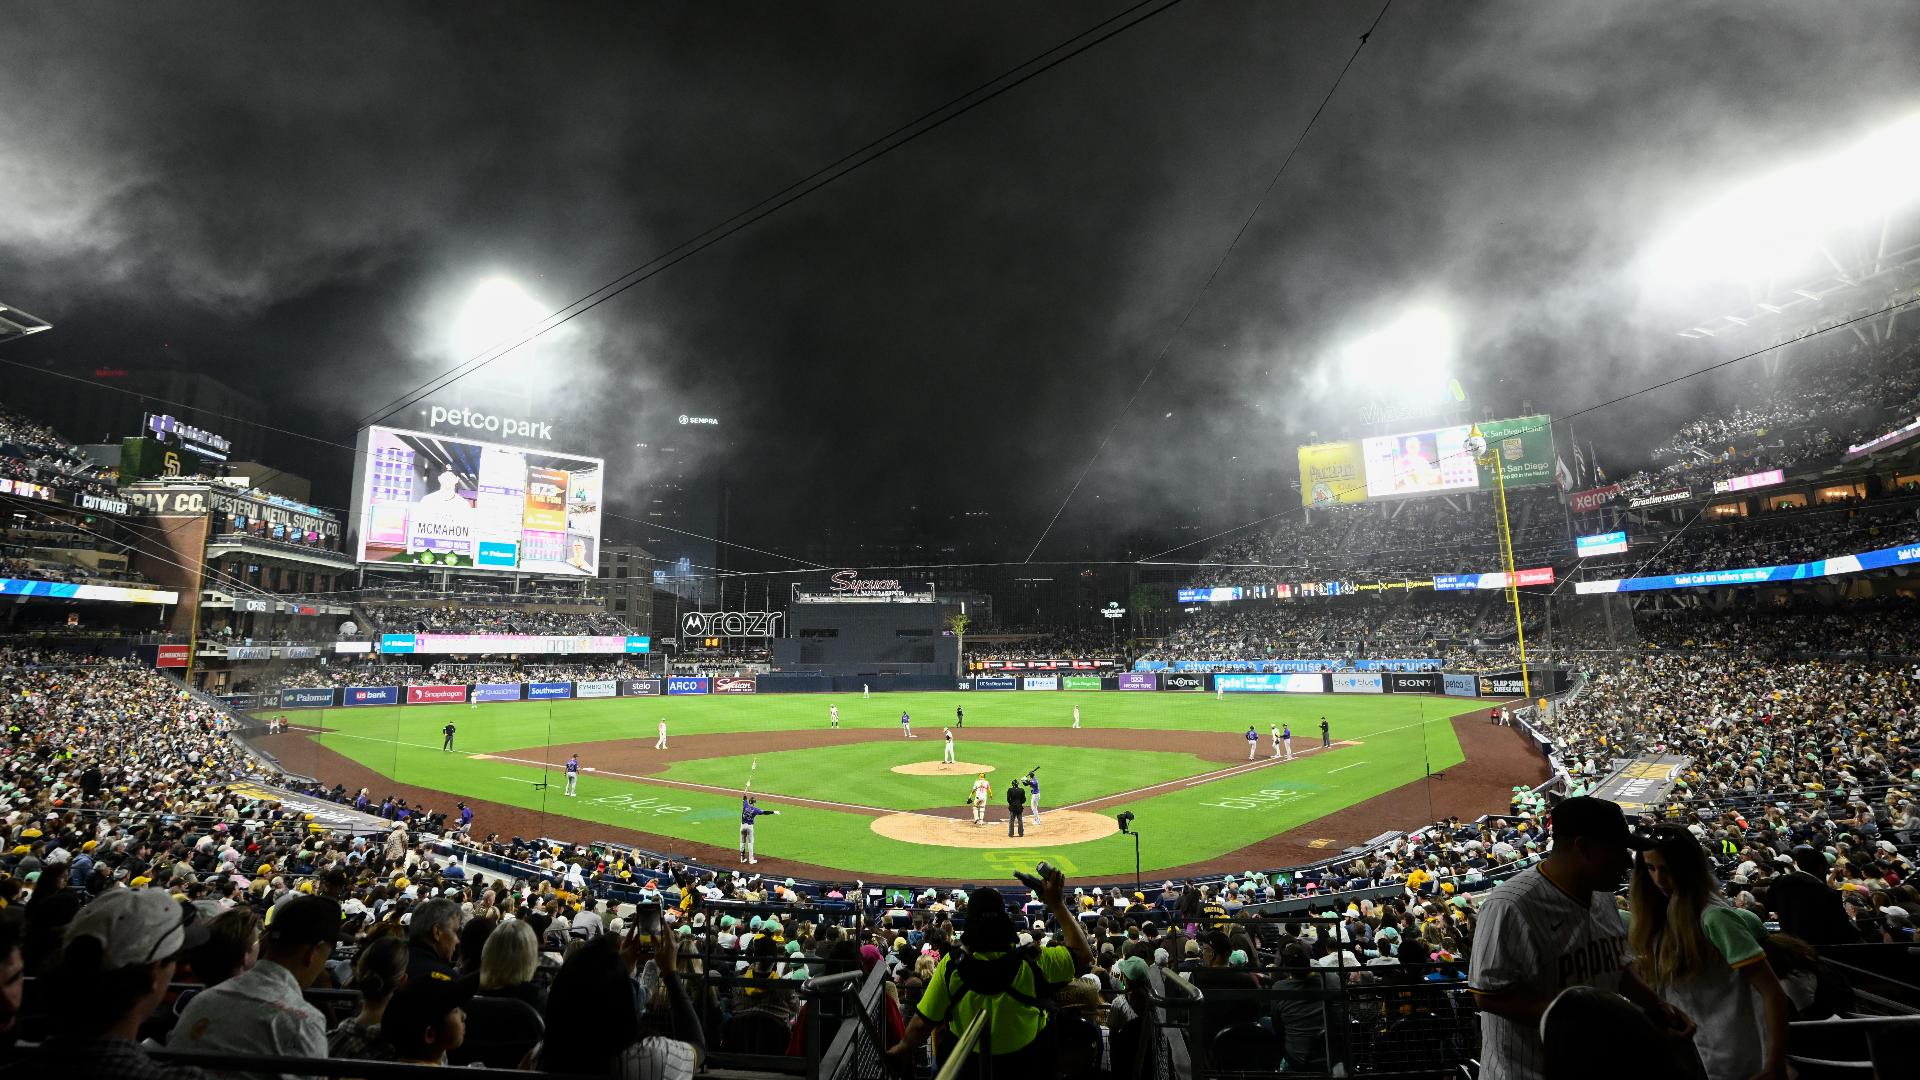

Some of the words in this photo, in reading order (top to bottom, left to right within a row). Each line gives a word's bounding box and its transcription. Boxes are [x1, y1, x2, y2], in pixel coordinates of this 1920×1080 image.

[430, 404, 499, 431] petco
[502, 418, 553, 440] park
[689, 417, 719, 425] SEMPRA
[1491, 430, 1503, 438] San
[1507, 464, 1523, 473] San
[1523, 462, 1549, 472] Diego
[174, 494, 207, 513] CO.
[531, 494, 546, 503] THE
[1629, 494, 1661, 508] Tarantino
[1662, 490, 1691, 502] SAUSAGES
[82, 495, 128, 515] CUTWATER
[210, 491, 258, 519] WESTERN
[261, 505, 291, 525] METAL
[293, 513, 325, 534] SUPPLY
[326, 522, 340, 536] CO.
[417, 522, 469, 537] MCMAHON
[829, 569, 901, 597] Sycuan
[246, 600, 267, 612] ORIS
[706, 611, 782, 637] razr
[1262, 661, 1328, 673] citycruise
[632, 682, 651, 690] stelo
[669, 681, 697, 691] ARCO
[717, 679, 751, 692] Sycuan
[1167, 678, 1200, 687] EVOTEK
[1334, 678, 1350, 687] blue
[1357, 678, 1374, 687] blue
[1398, 679, 1433, 687] SONY
[1445, 679, 1464, 690] petco
[356, 691, 366, 699] us
[367, 690, 387, 699] bank
[424, 690, 463, 699] Snapdragon
[531, 687, 564, 695] Southwest
[263, 697, 278, 706] 342
[296, 693, 331, 702] Palomar
